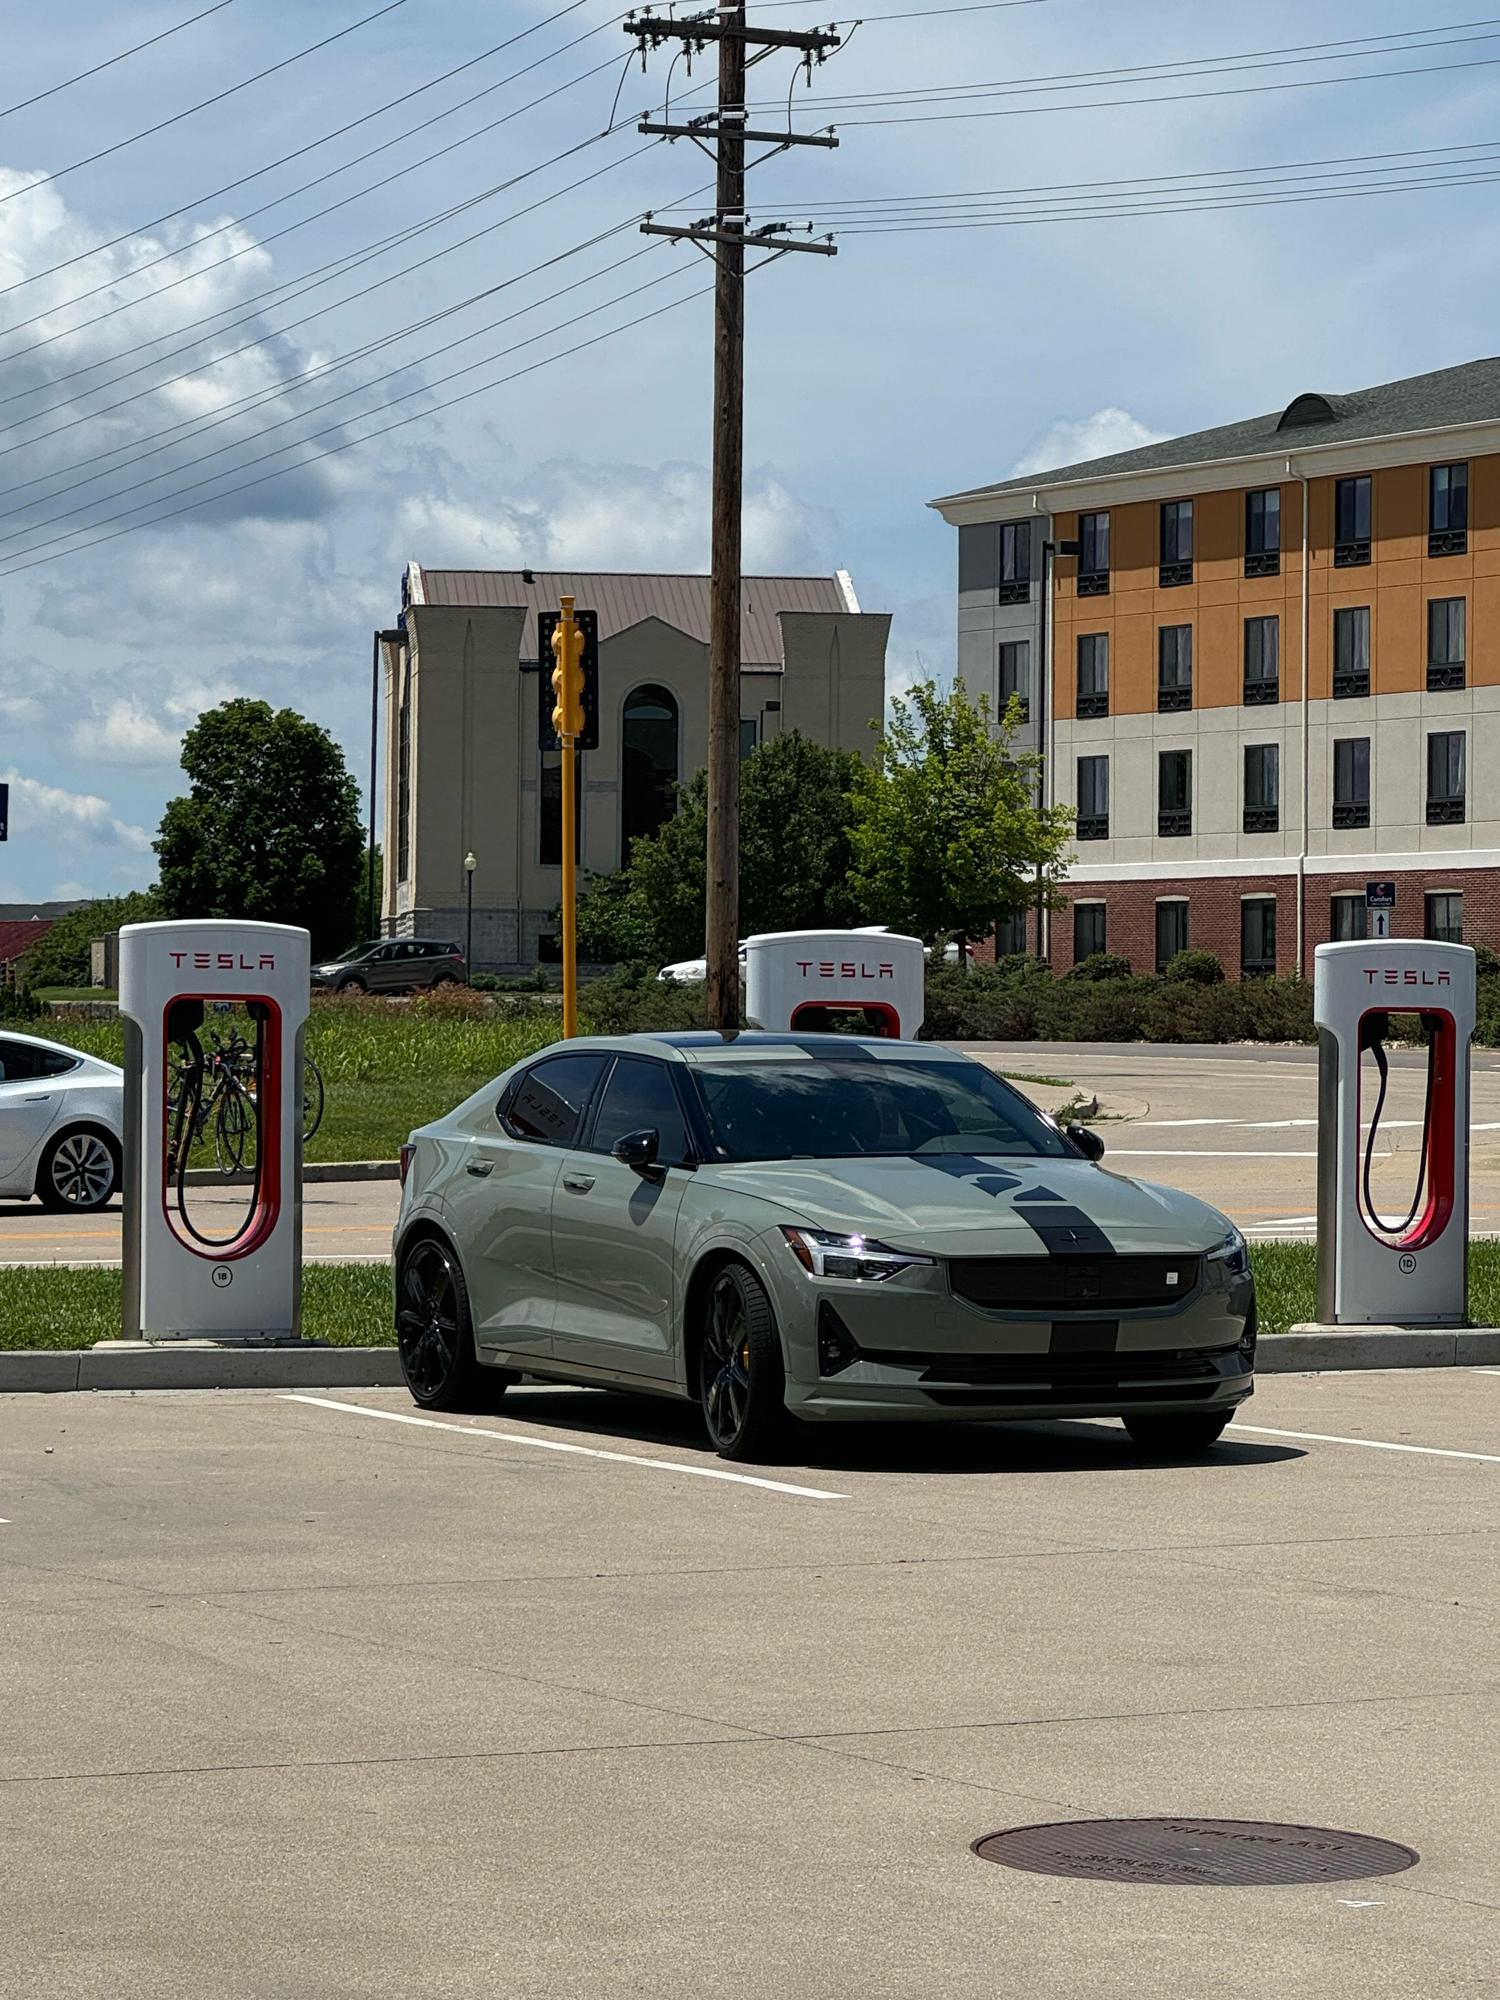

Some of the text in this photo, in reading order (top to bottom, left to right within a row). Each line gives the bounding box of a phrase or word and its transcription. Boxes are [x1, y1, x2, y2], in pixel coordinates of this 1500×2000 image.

[169, 952, 275, 971] TESLA
[796, 962, 893, 979] TESLA
[1362, 969, 1450, 986] TESLA
